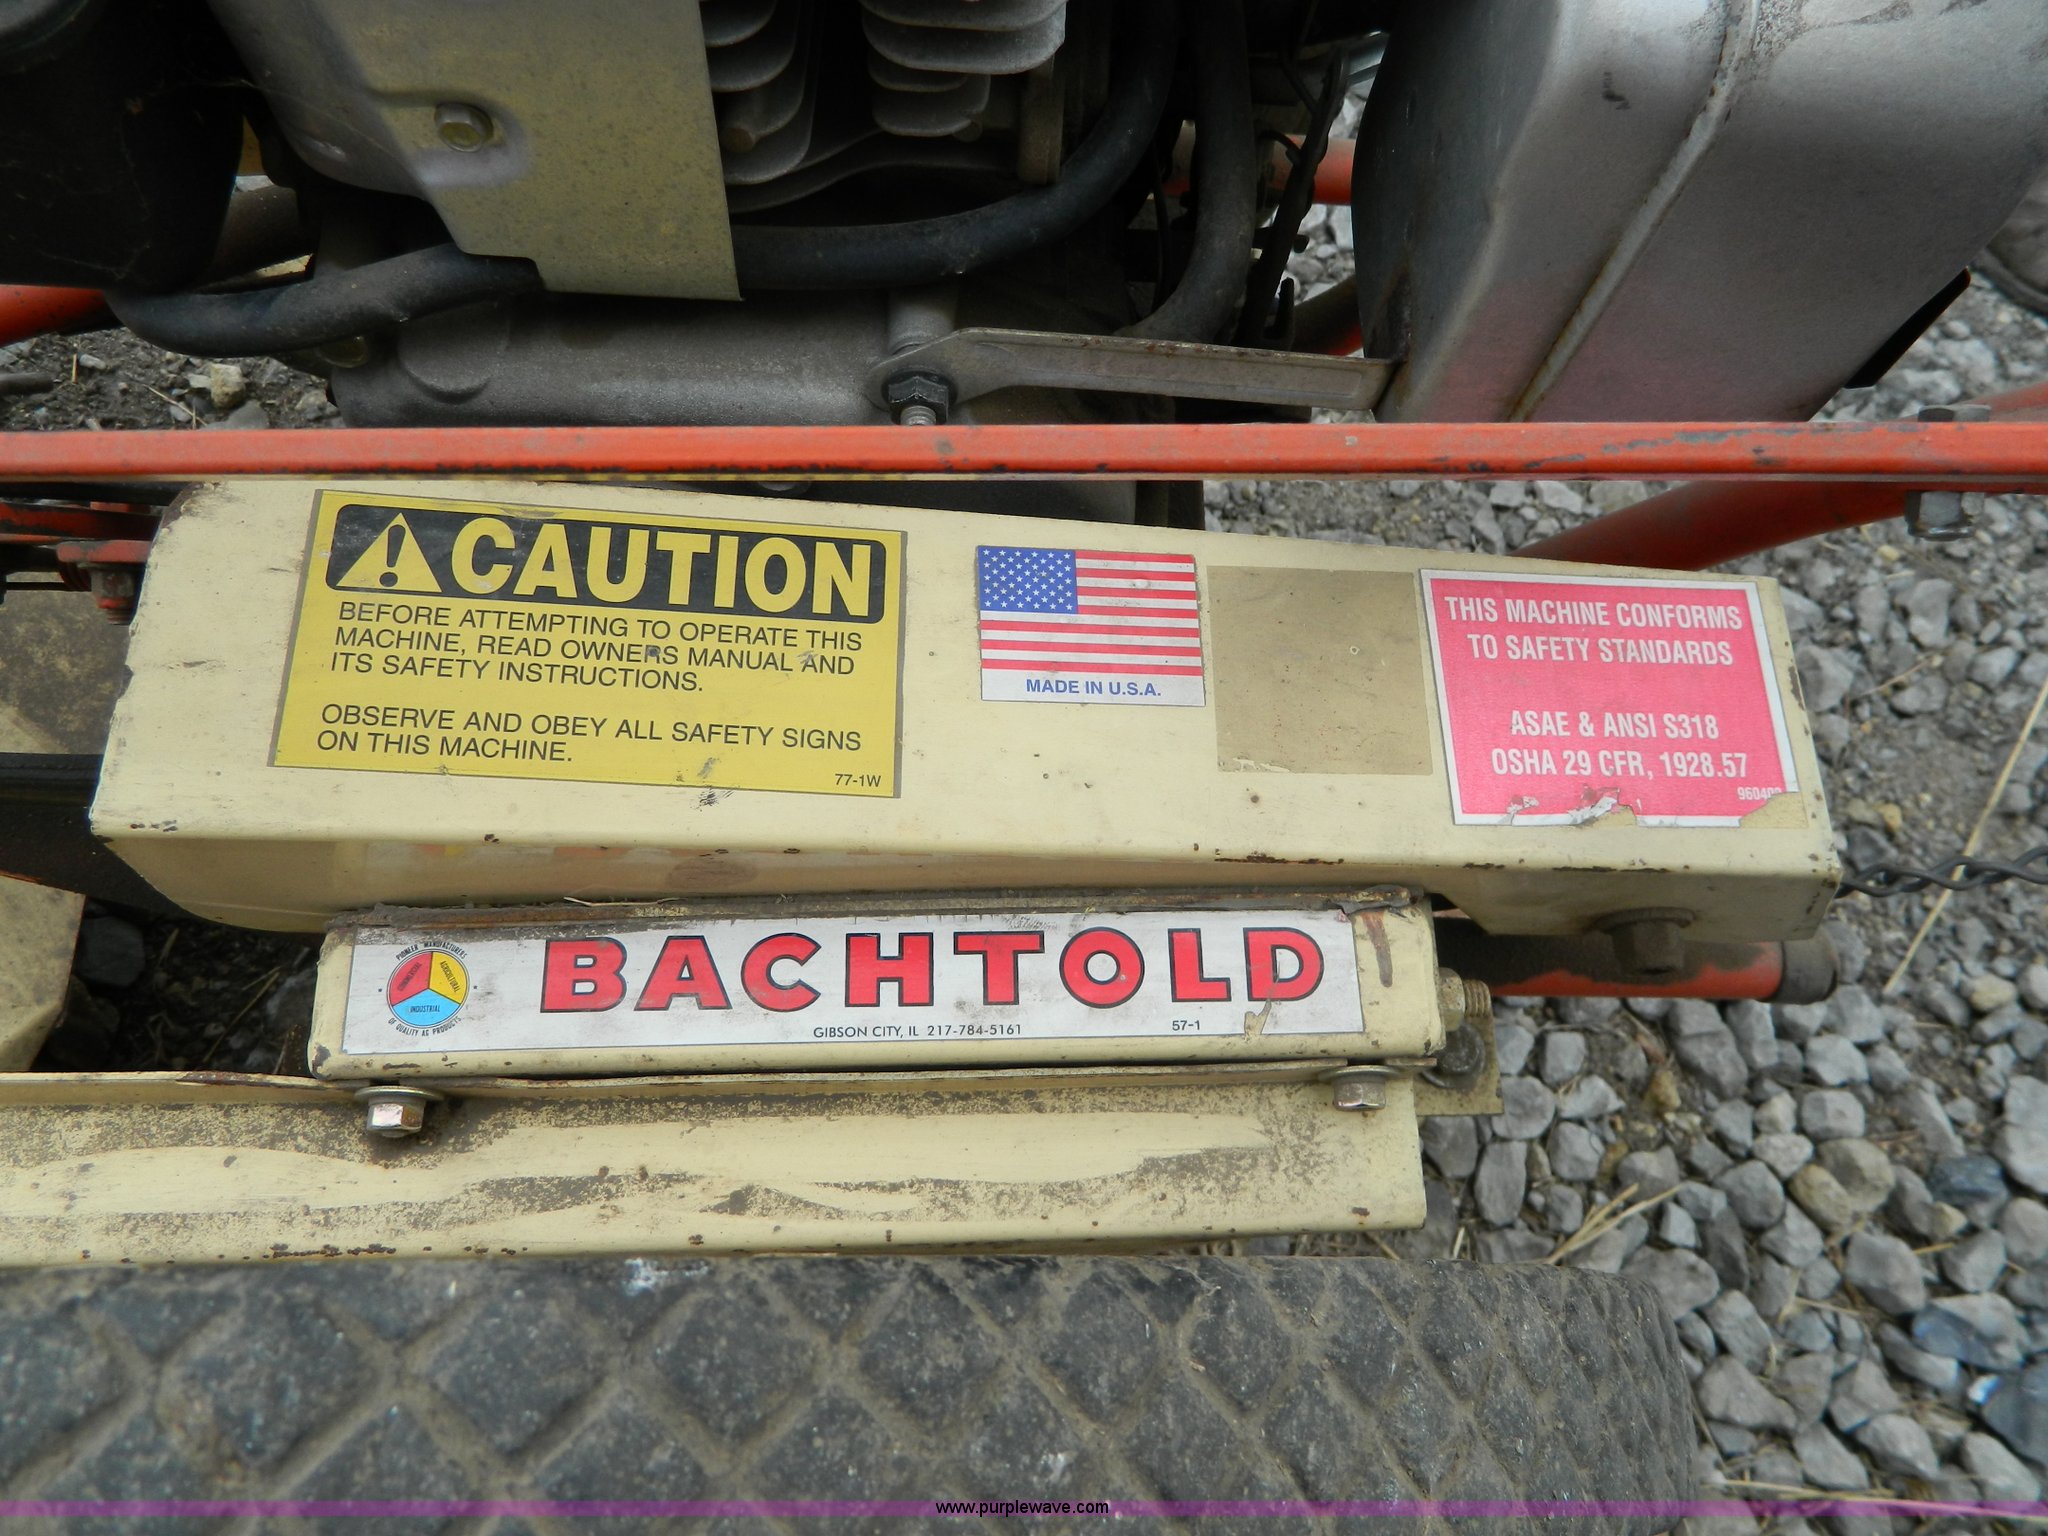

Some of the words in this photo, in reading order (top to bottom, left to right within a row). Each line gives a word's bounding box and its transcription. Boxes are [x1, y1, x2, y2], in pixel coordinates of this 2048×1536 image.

[450, 516, 874, 618] CAUTION
[338, 601, 451, 627] BEFORE
[458, 608, 629, 637] ATTEMPTING
[636, 619, 671, 640] TO
[679, 622, 799, 648] OPERATE
[805, 629, 863, 651] THIS
[1444, 596, 1499, 624] THIS
[1505, 598, 1610, 628] MACHINE
[1616, 602, 1743, 631] CONFORMS
[335, 626, 467, 656] MACHINE,
[477, 634, 552, 658] READ
[560, 639, 679, 665] OWNERS
[687, 647, 794, 672] MANUAL
[801, 653, 855, 676] AND
[1467, 633, 1499, 660] TO
[1506, 634, 1590, 663] SAFETY
[1598, 638, 1734, 666] STANDARDS
[331, 652, 373, 673] ITS
[382, 654, 491, 680] SAFETY
[498, 661, 703, 692] INSTRUCTIONS.
[1025, 678, 1080, 694] MADE
[1085, 680, 1103, 695] IN
[1108, 681, 1162, 697] U.S.A.
[321, 703, 456, 730] OBSERVE
[463, 711, 522, 733] AND
[531, 714, 609, 738] OBEY
[614, 719, 663, 741] ALL
[671, 721, 775, 746] SAFETY
[782, 727, 862, 751] SIGNS
[1510, 710, 1571, 738] ASAE
[1578, 712, 1596, 739] &
[1603, 712, 1657, 739] ANSI
[1664, 714, 1719, 740] S318
[317, 729, 360, 752] ON
[367, 732, 431, 755] THIS
[439, 736, 573, 762] MACHINE.
[834, 773, 882, 788] 77-1W
[1491, 748, 1557, 777] OSHA
[1562, 749, 1592, 778] 29
[1598, 749, 1655, 781] CFR,
[1659, 752, 1748, 779] 1928.57
[539, 926, 1326, 1013] BACHTOLD
[410, 1005, 440, 1013] INDUSTRIAL
[388, 1017, 397, 1025] OF
[395, 1024, 419, 1036] QUALITY
[421, 1029, 429, 1037] AG
[432, 1016, 462, 1035] PRODUCTS
[812, 1026, 868, 1039] GIBSON
[872, 1026, 904, 1040] CITY,
[908, 1025, 920, 1037] IL
[926, 1023, 1023, 1037] 217-784-5161
[1171, 1020, 1201, 1032] 57-1
